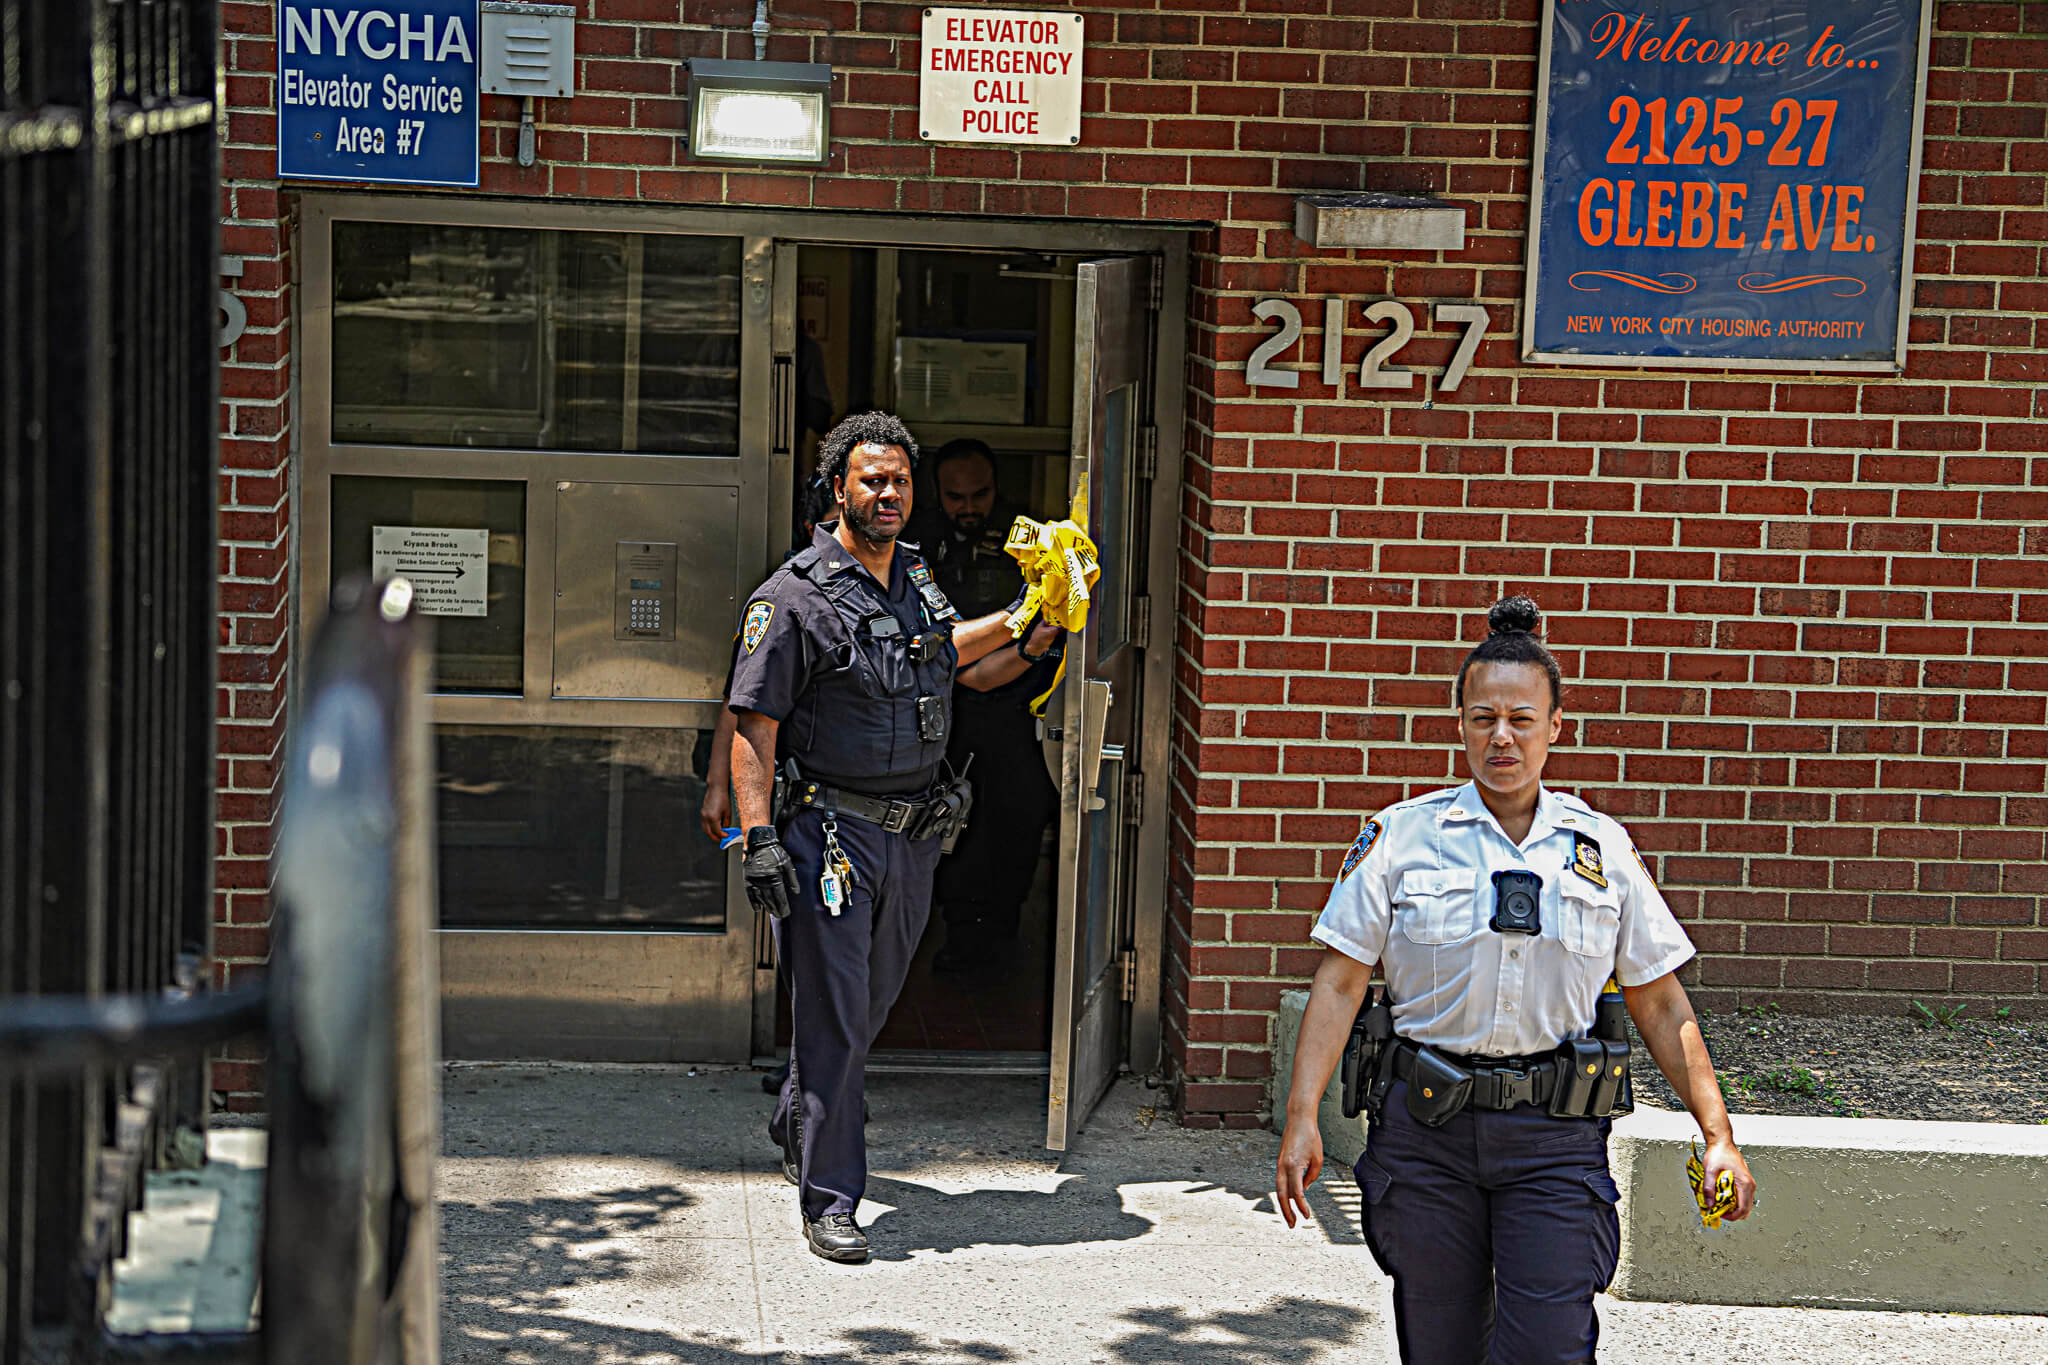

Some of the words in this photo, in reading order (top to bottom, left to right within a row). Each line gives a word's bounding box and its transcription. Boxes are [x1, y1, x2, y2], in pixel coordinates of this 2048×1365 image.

[285, 6, 473, 63] NYCHA
[946, 18, 1059, 44] ELEVATOR
[1590, 12, 1790, 66] Welcome
[1805, 25, 1879, 69] to...
[931, 48, 1073, 75] EMERGENCY
[284, 69, 371, 109] Elevator
[382, 73, 463, 114] Service
[973, 79, 1030, 105] CALL
[335, 117, 385, 155] Area
[397, 118, 425, 156] #7
[962, 109, 1039, 135] POLICE
[1606, 95, 1838, 167] 2125-27
[1578, 177, 1746, 250] GLEBE
[1762, 184, 1877, 254] AVE.
[1566, 315, 1603, 333] NEW
[1610, 316, 1653, 334] YORK
[1659, 317, 1695, 335] CITY
[1701, 318, 1771, 337] HOUSING
[1778, 320, 1865, 339] AUTHORITY
[1245, 298, 1490, 393] 2127
[403, 539, 430, 549] Kiyana
[431, 541, 458, 549] Brooks
[430, 586, 457, 595] Brooks
